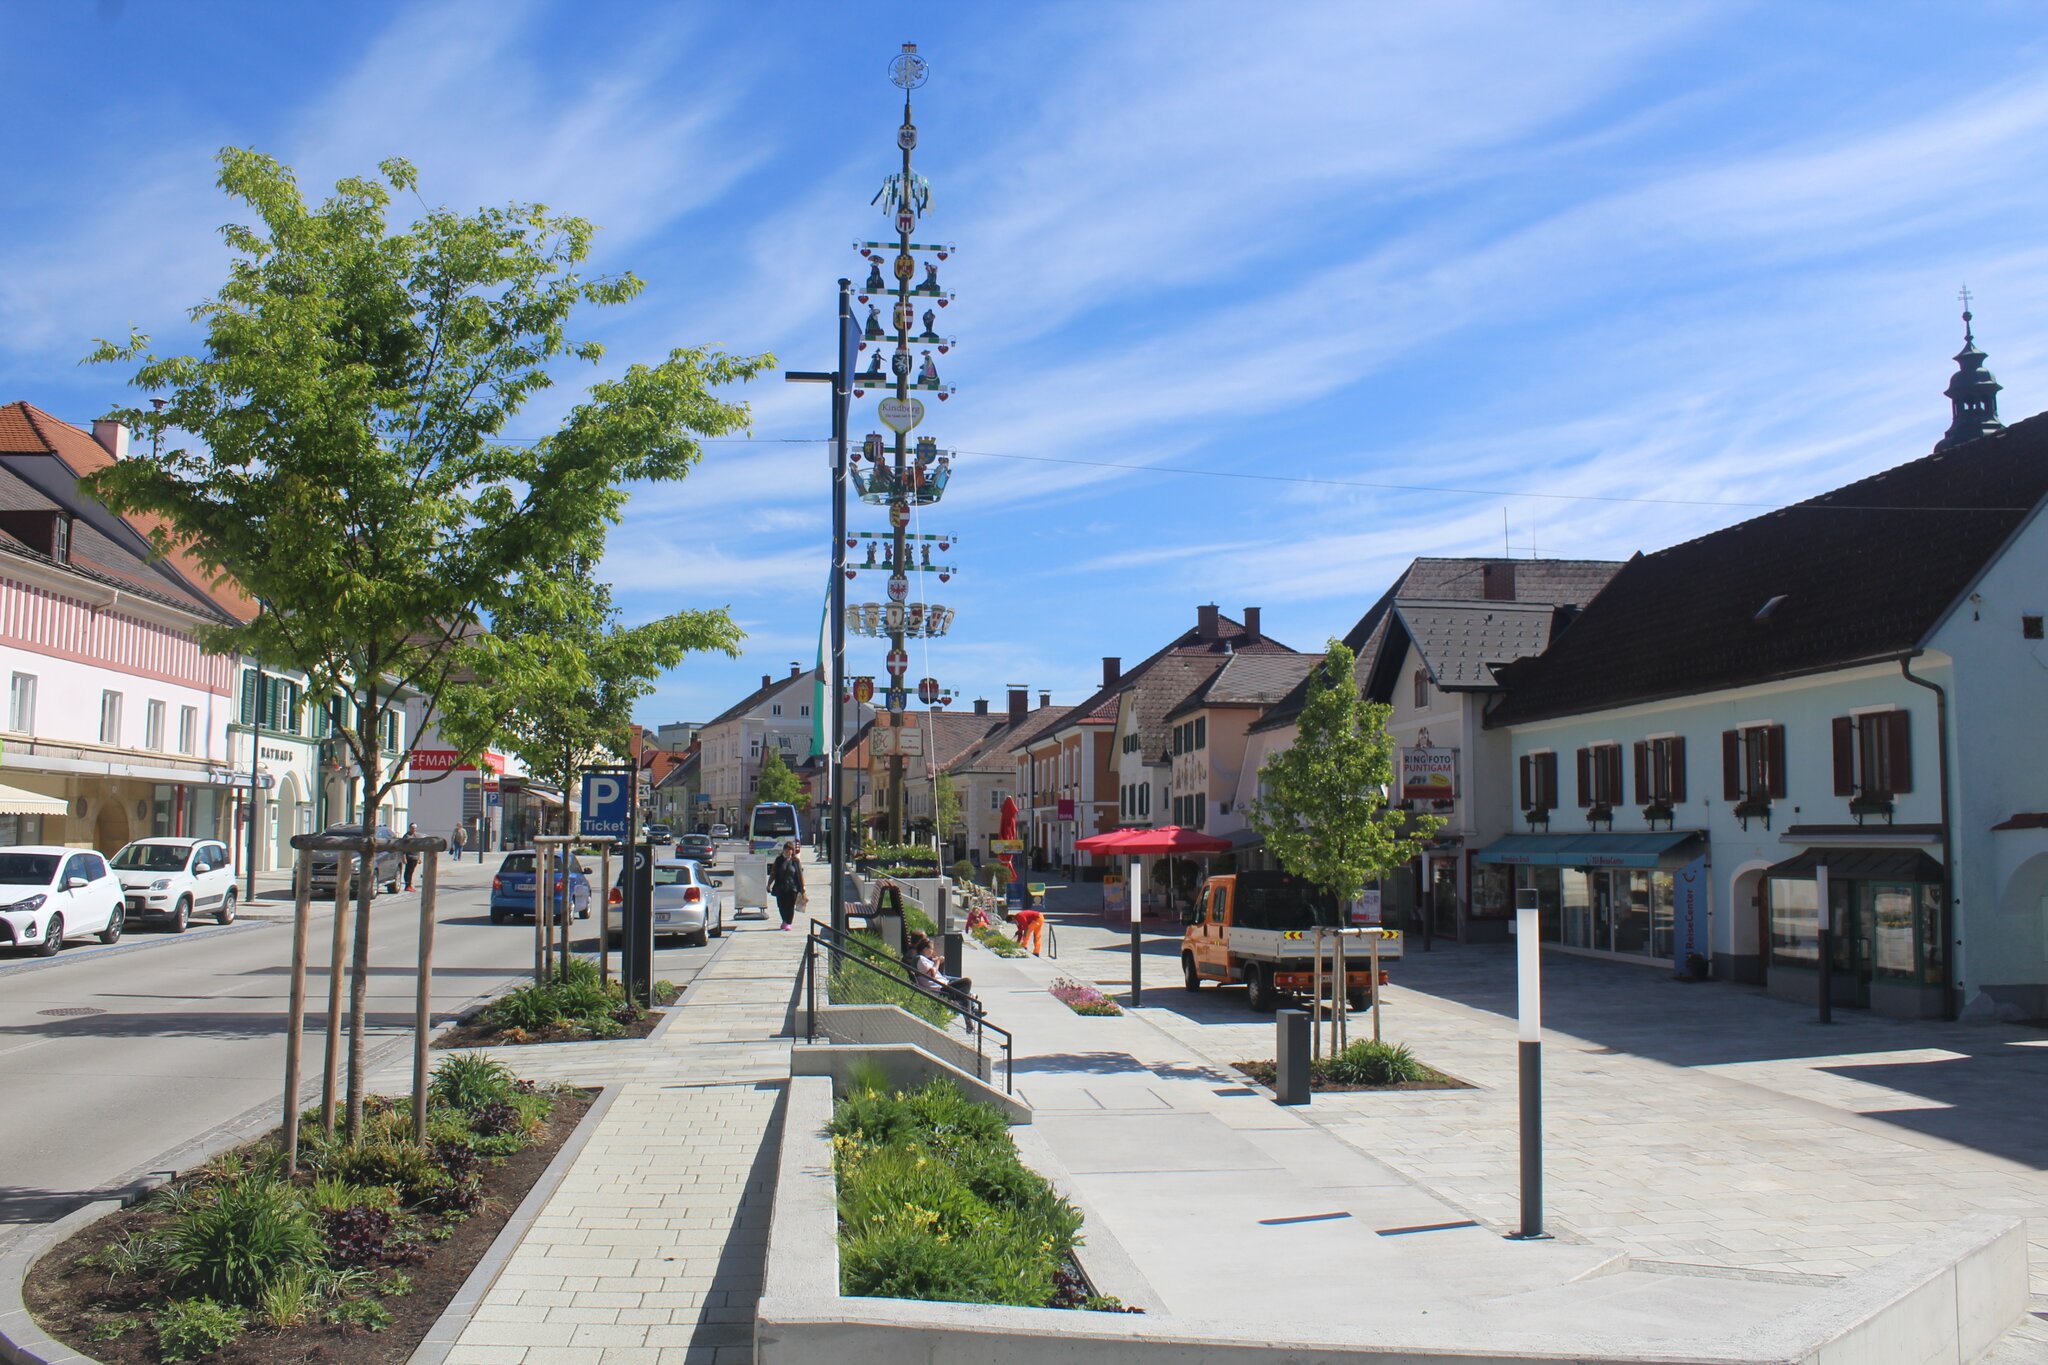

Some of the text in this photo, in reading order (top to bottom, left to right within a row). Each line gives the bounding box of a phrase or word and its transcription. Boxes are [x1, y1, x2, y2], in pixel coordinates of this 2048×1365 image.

[261, 747, 293, 762] RATHAUS
[1405, 755, 1451, 764] RING FOTO
[1405, 764, 1451, 772] PUNTIGAM
[490, 794, 497, 803] P
[589, 777, 620, 817] P
[583, 820, 625, 832] Ticket
